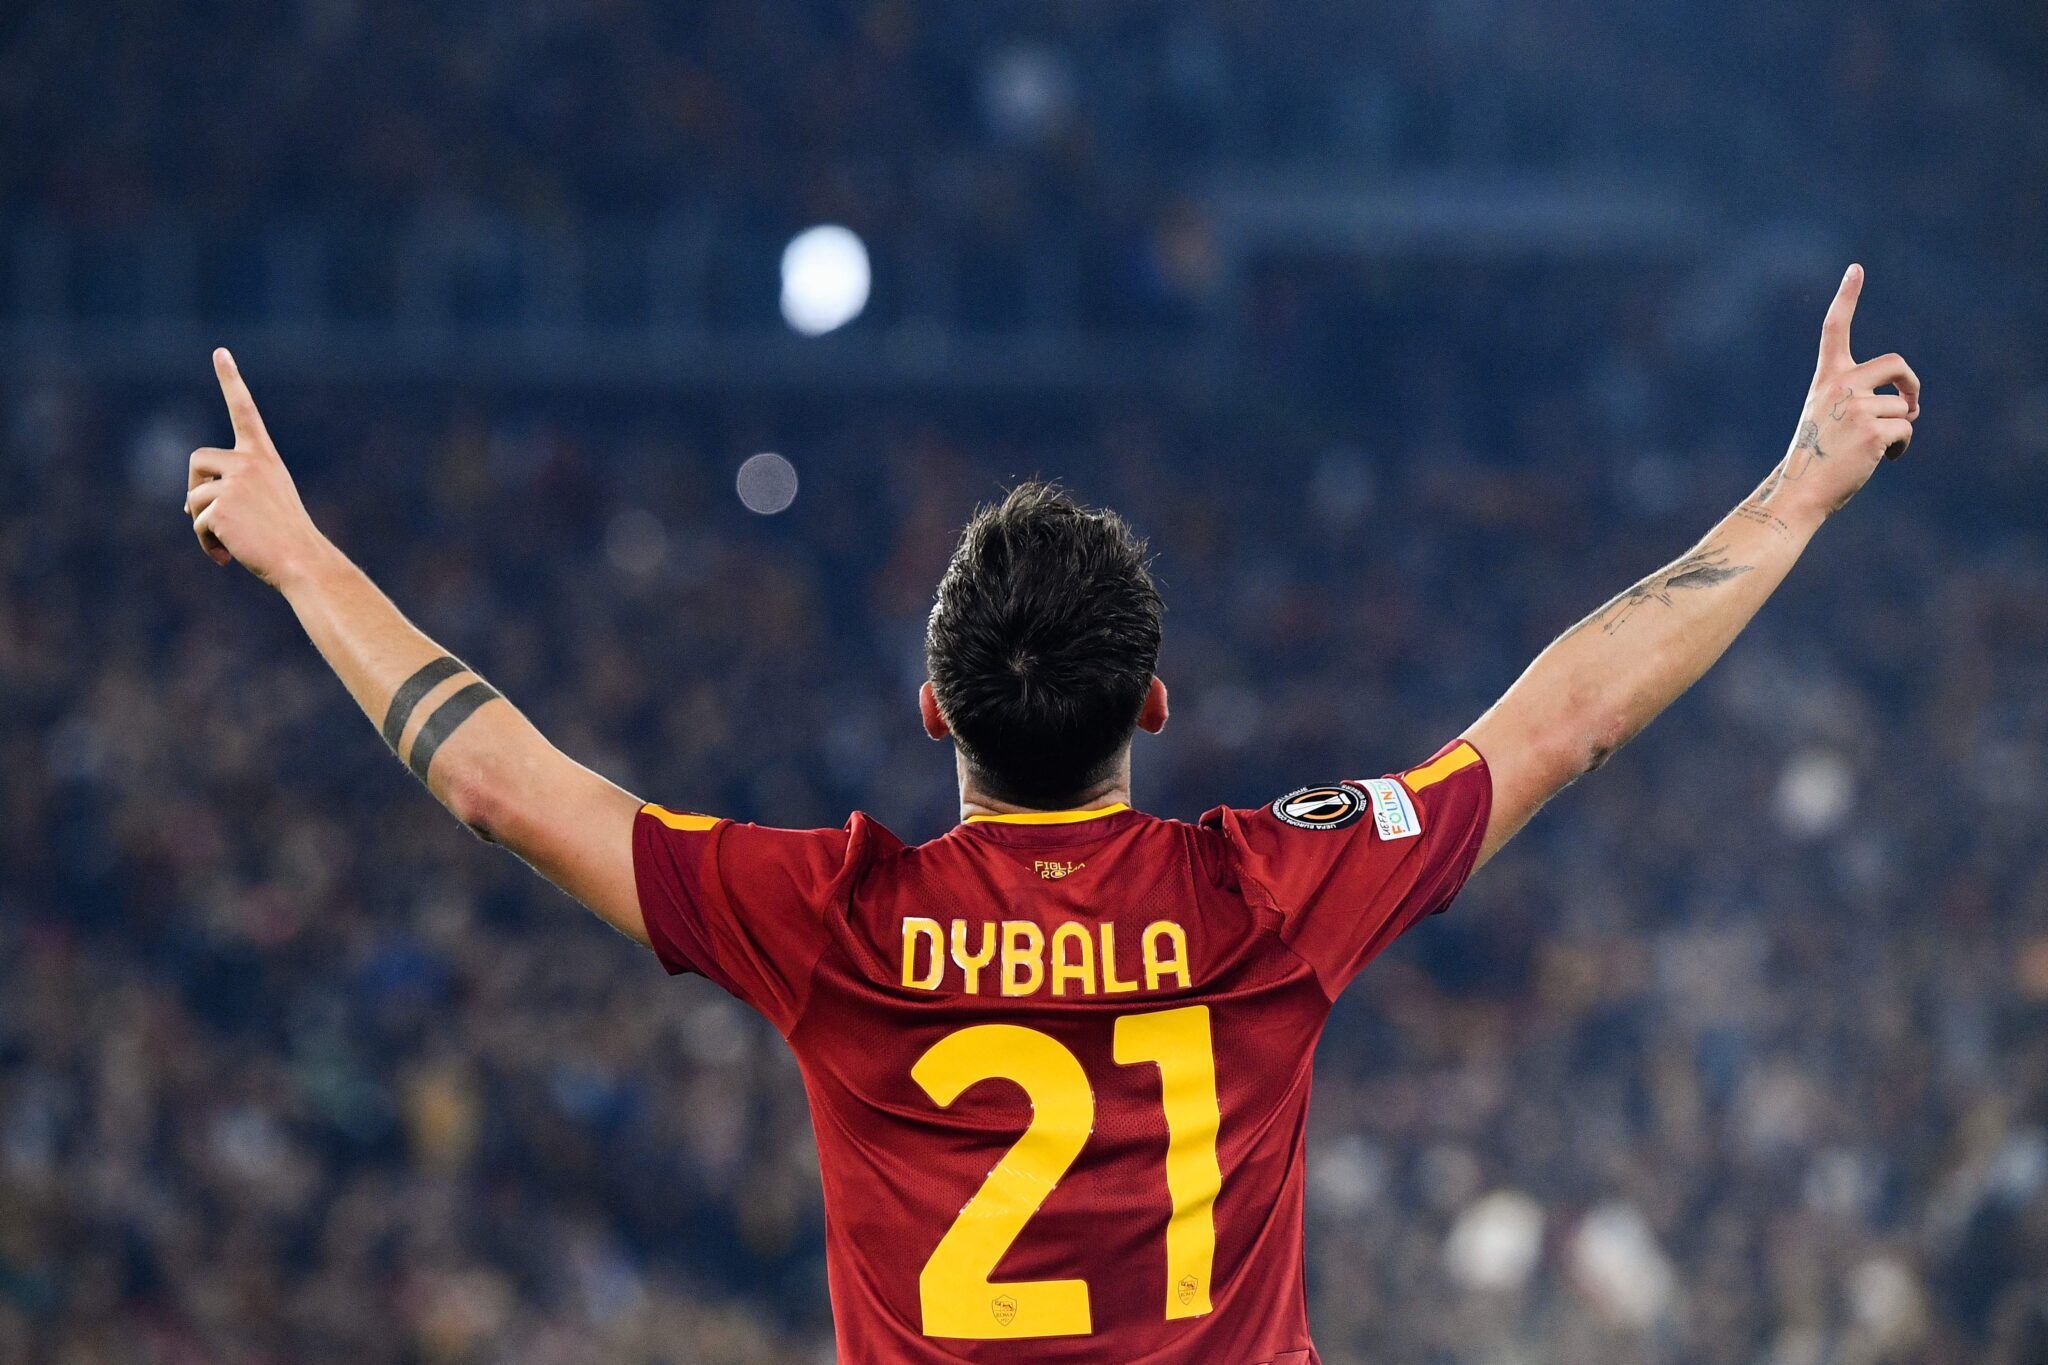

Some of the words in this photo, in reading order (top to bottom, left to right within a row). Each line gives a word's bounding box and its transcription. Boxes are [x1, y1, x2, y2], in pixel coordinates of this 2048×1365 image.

[1377, 812, 1391, 836] UEFA
[1034, 860, 1073, 872] FIGLI
[902, 916, 1191, 997] DYBALA
[911, 1004, 1222, 1340] 21
